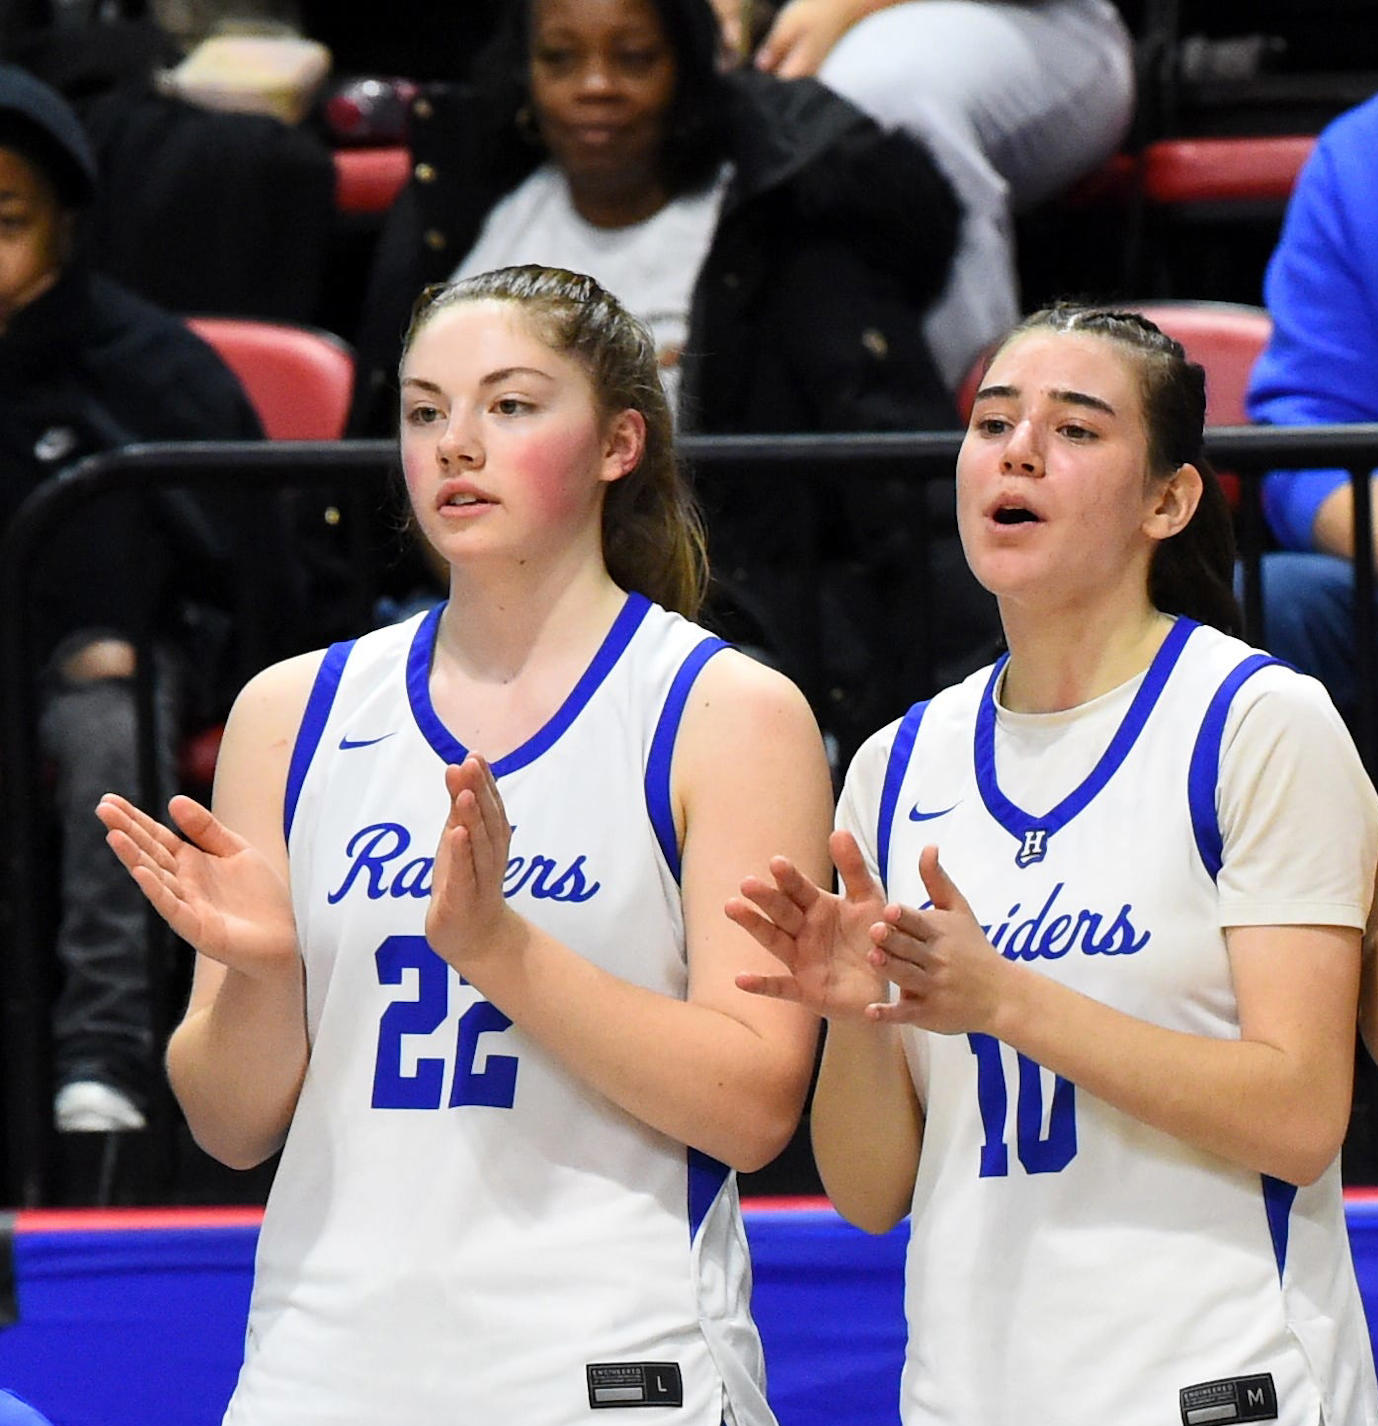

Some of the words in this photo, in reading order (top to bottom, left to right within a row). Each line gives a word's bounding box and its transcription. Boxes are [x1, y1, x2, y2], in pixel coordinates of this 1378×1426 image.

[327, 822, 600, 905] Raers
[1020, 830, 1046, 856] H
[918, 882, 1152, 962] iders
[371, 935, 520, 1110] 22
[970, 1032, 1079, 1178] 10
[657, 1375, 668, 1392] L
[1246, 1387, 1265, 1407] M
